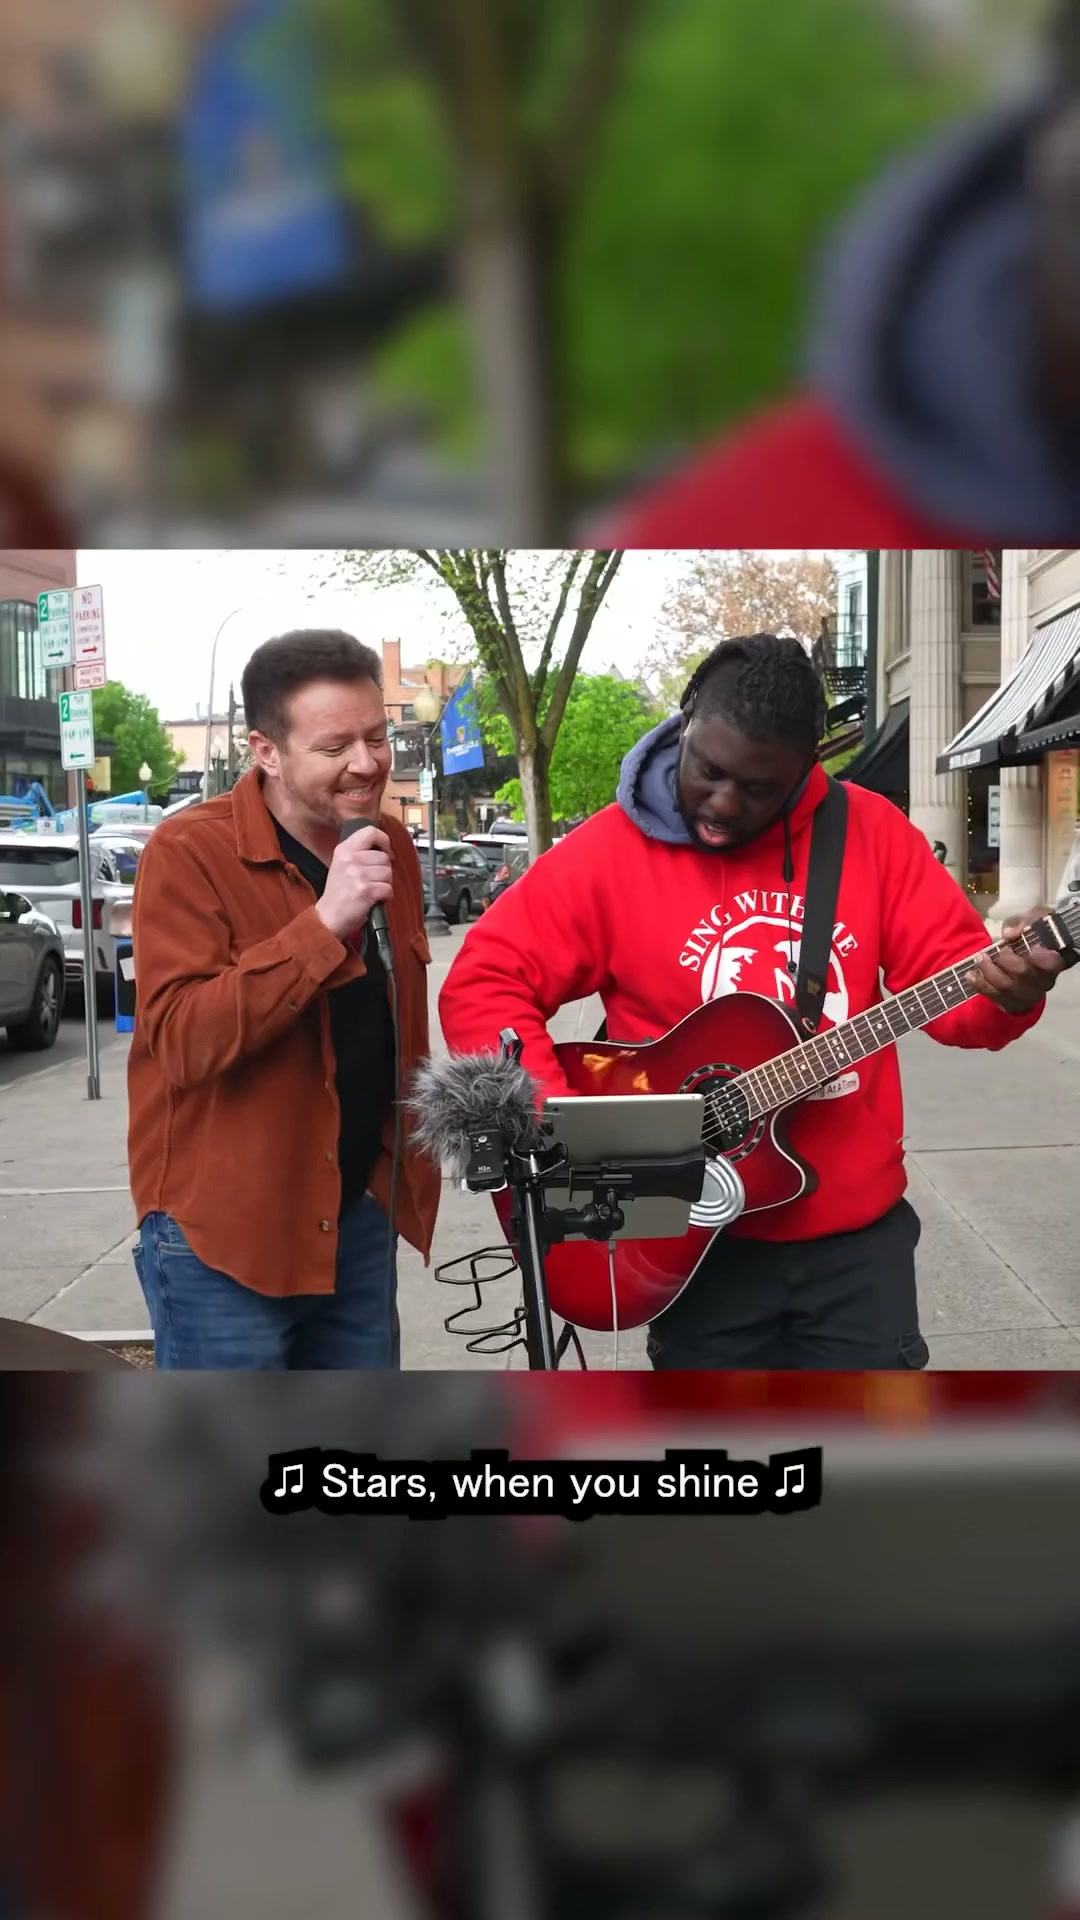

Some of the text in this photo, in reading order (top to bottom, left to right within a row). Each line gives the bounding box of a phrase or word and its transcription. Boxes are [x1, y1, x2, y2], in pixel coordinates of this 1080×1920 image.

[82, 591, 92, 605] NO
[40, 599, 48, 618] 2
[62, 698, 69, 719] 2
[679, 904, 733, 972] SING
[733, 889, 805, 919] WITH
